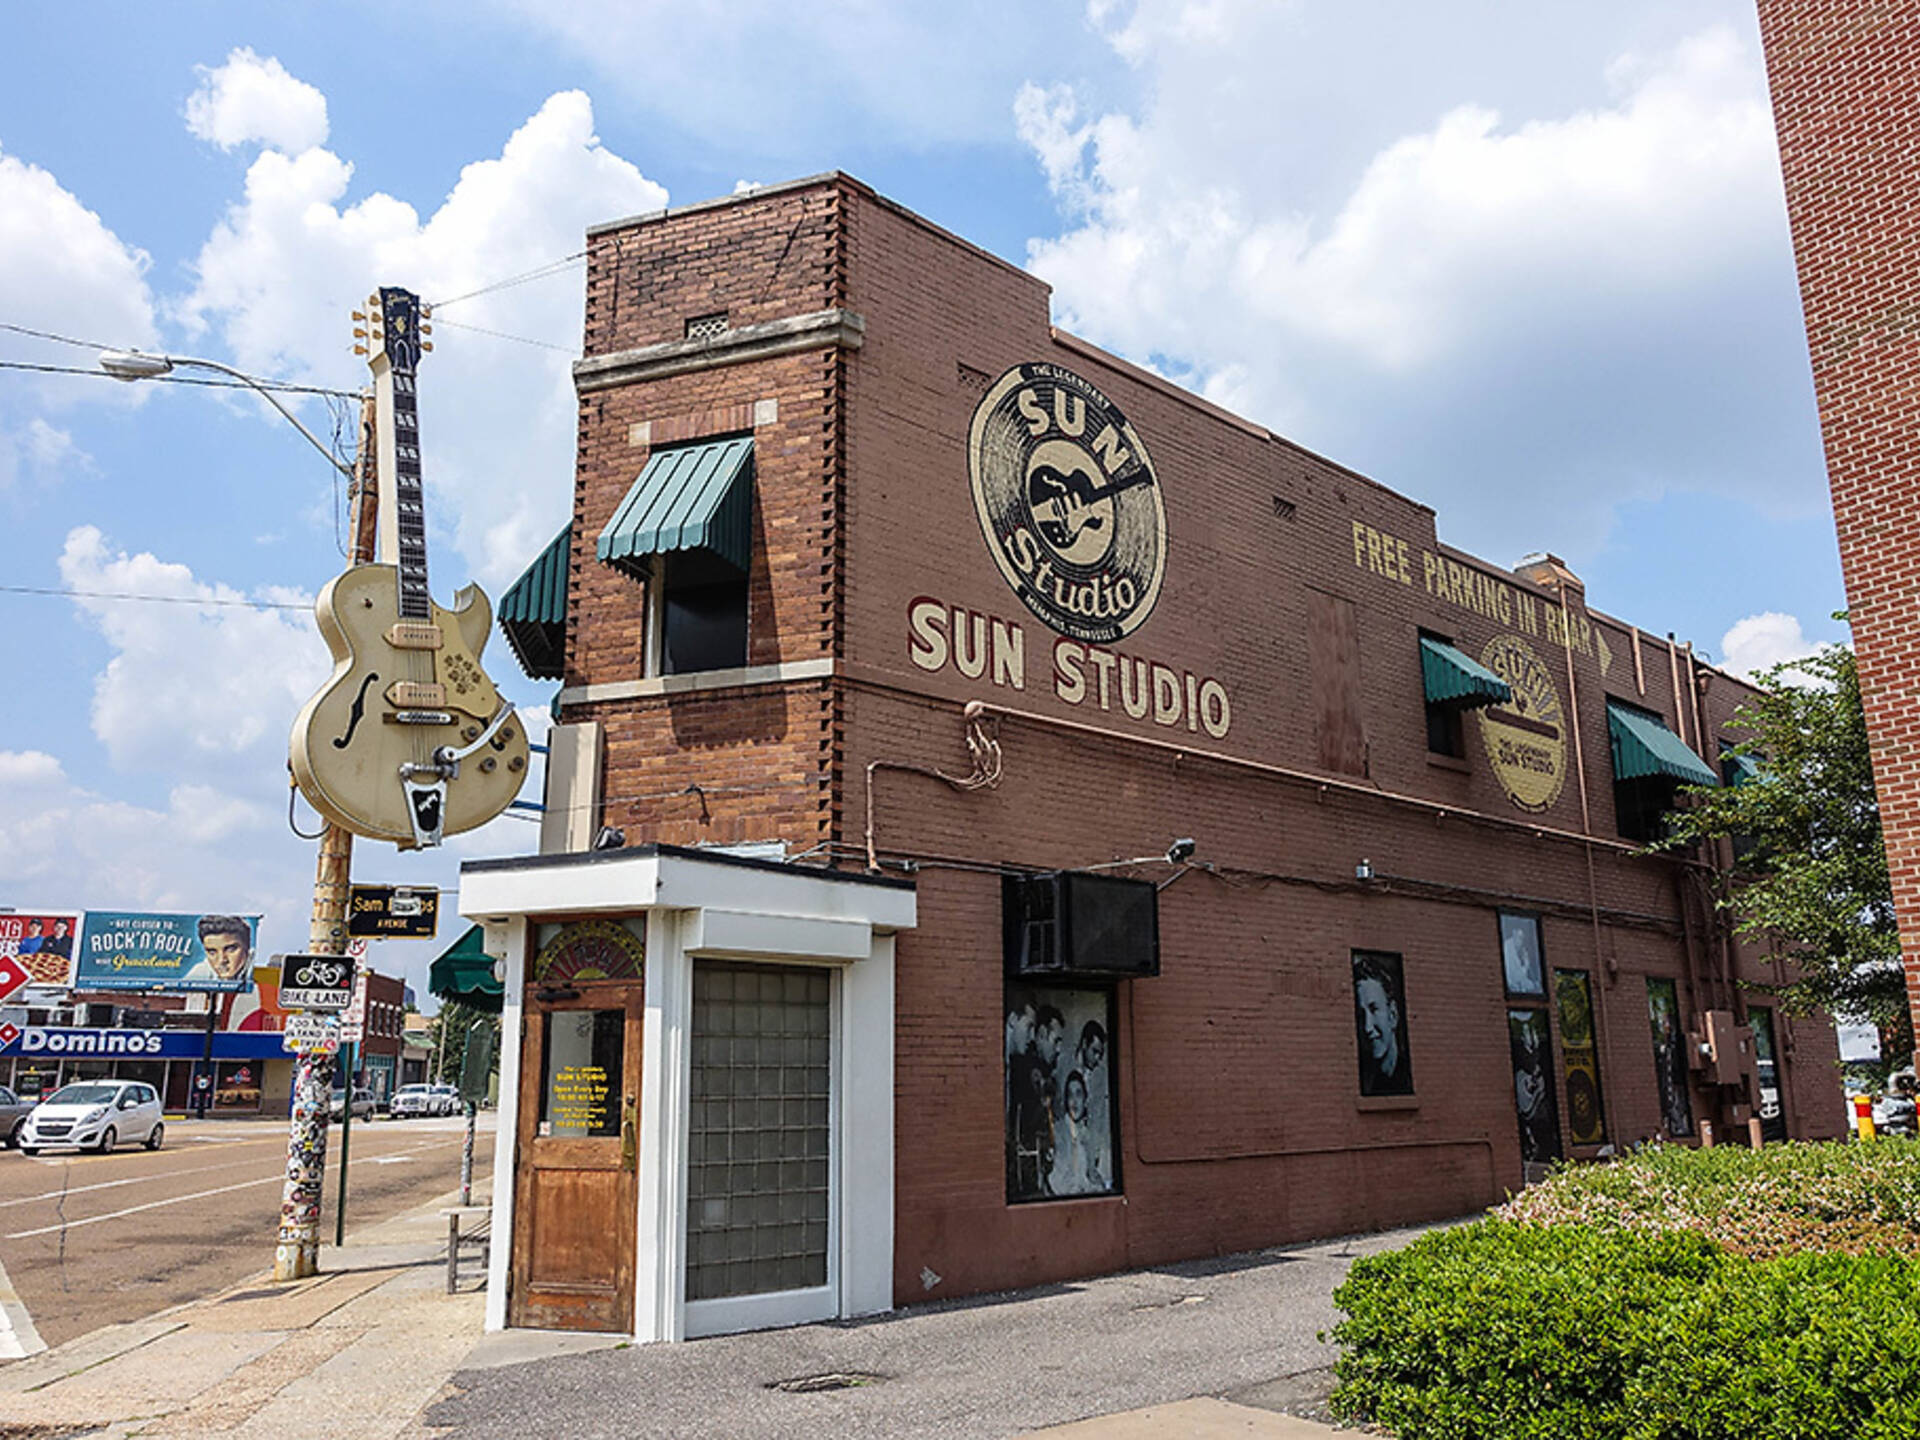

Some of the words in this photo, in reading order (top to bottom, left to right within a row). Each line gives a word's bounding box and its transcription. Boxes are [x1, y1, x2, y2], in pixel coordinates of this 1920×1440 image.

[1018, 387, 1131, 475] SUN
[1004, 527, 1136, 618] Studio
[1351, 521, 1412, 586] FREE
[1423, 551, 1511, 625] PARKING
[1516, 590, 1537, 637] IN
[907, 596, 1026, 690] SUN
[1053, 637, 1231, 739] STUDIO
[354, 896, 383, 912] Sam
[113, 953, 183, 971] Graceland
[281, 991, 309, 1004] BIKE
[315, 992, 346, 1005] LANE
[22, 1029, 162, 1053] Domino's
